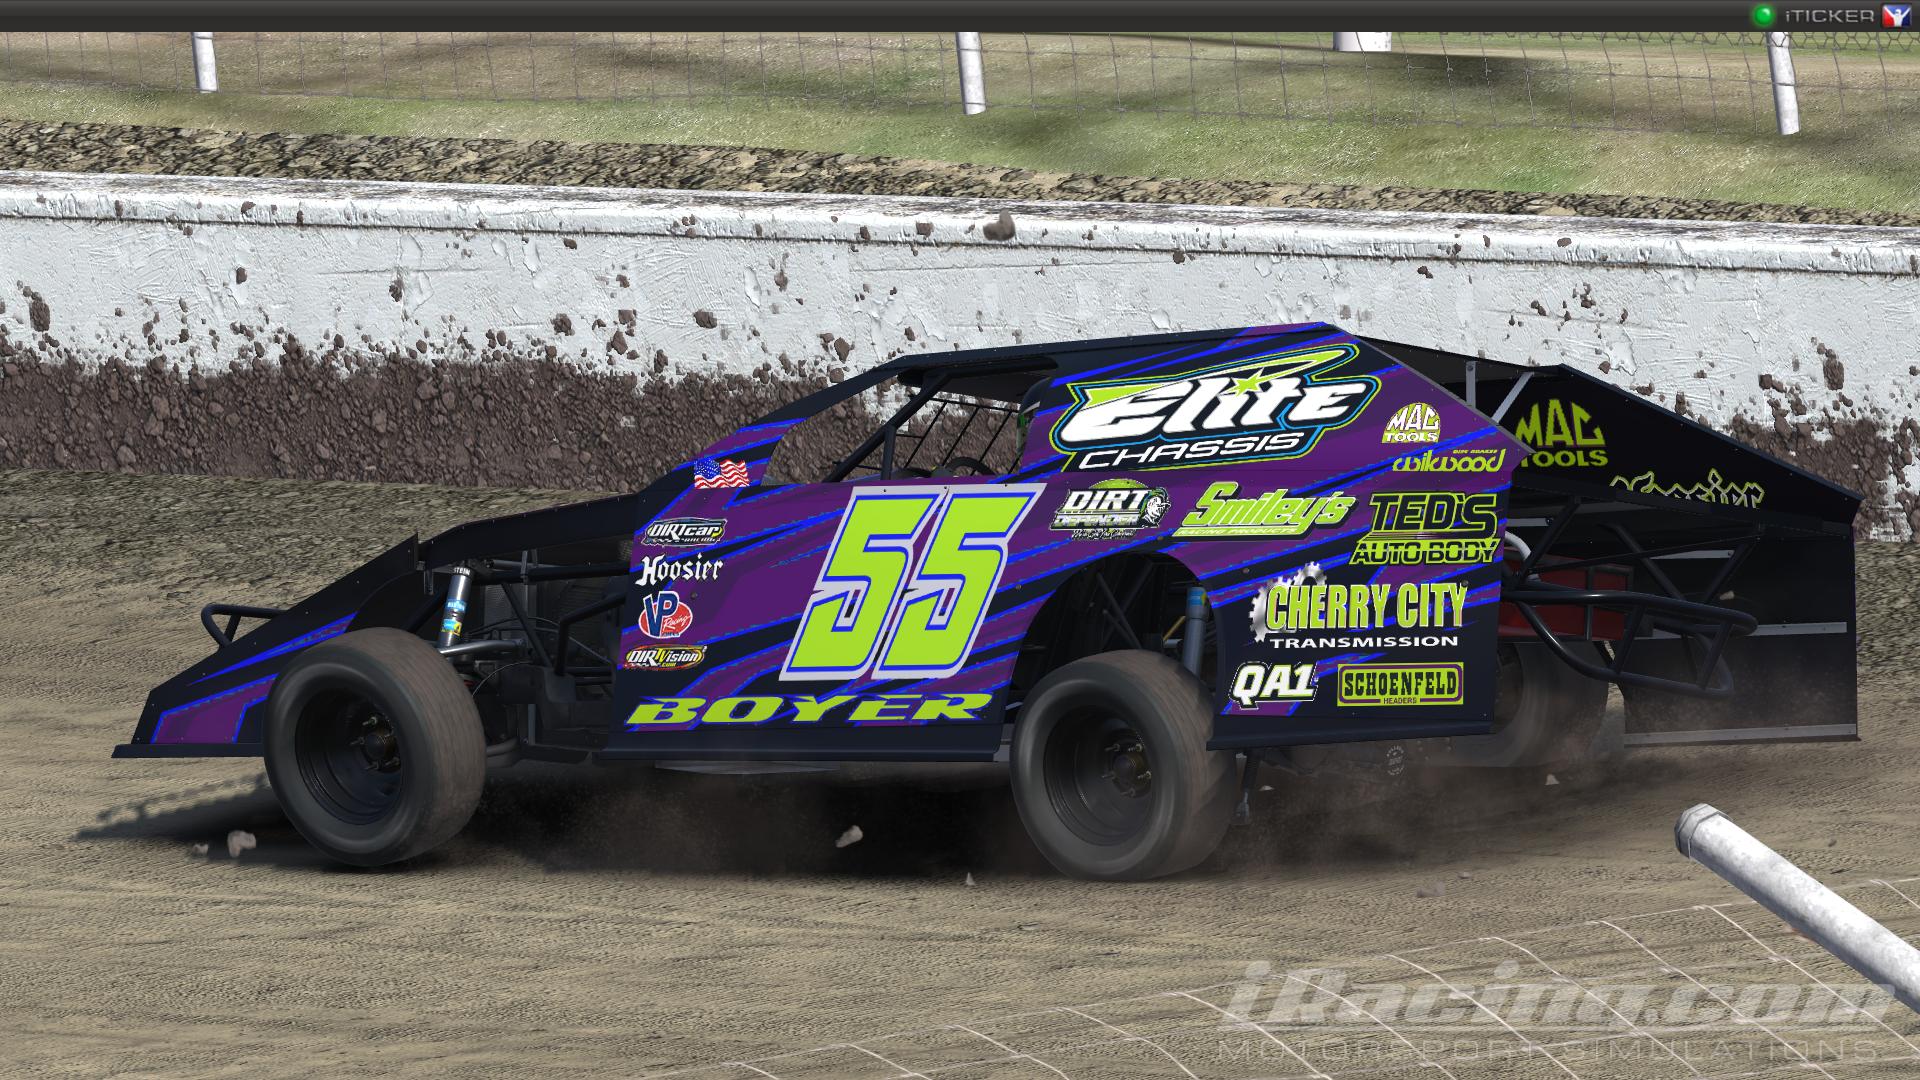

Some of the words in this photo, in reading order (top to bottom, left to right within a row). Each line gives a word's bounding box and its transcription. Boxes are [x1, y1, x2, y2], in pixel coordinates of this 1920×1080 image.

[1060, 356, 1367, 442] Elite
[1386, 404, 1439, 431] MAC
[1515, 398, 1605, 446] MAC
[1079, 432, 1304, 470] CHASSIS
[1384, 432, 1439, 442] TOOLS
[1062, 490, 1150, 510] DIRT
[1182, 481, 1356, 533] Smiley's
[1370, 492, 1498, 540] TED'S
[649, 523, 720, 540] DIRTcar
[1351, 541, 1422, 564] AUTO
[1426, 541, 1498, 563] BODY
[635, 552, 724, 586] Hoosier
[783, 489, 1041, 676] 55
[643, 591, 680, 638] VP
[1266, 583, 1391, 630] CHERRY
[1397, 582, 1468, 628] CITY
[663, 614, 690, 632] Racing
[1270, 636, 1458, 649] TRANSMISSION
[1232, 664, 1317, 706] QA1
[1344, 671, 1457, 697] SCHOENFELD
[625, 694, 993, 724] BOYER
[1383, 697, 1418, 705] HEADERS
